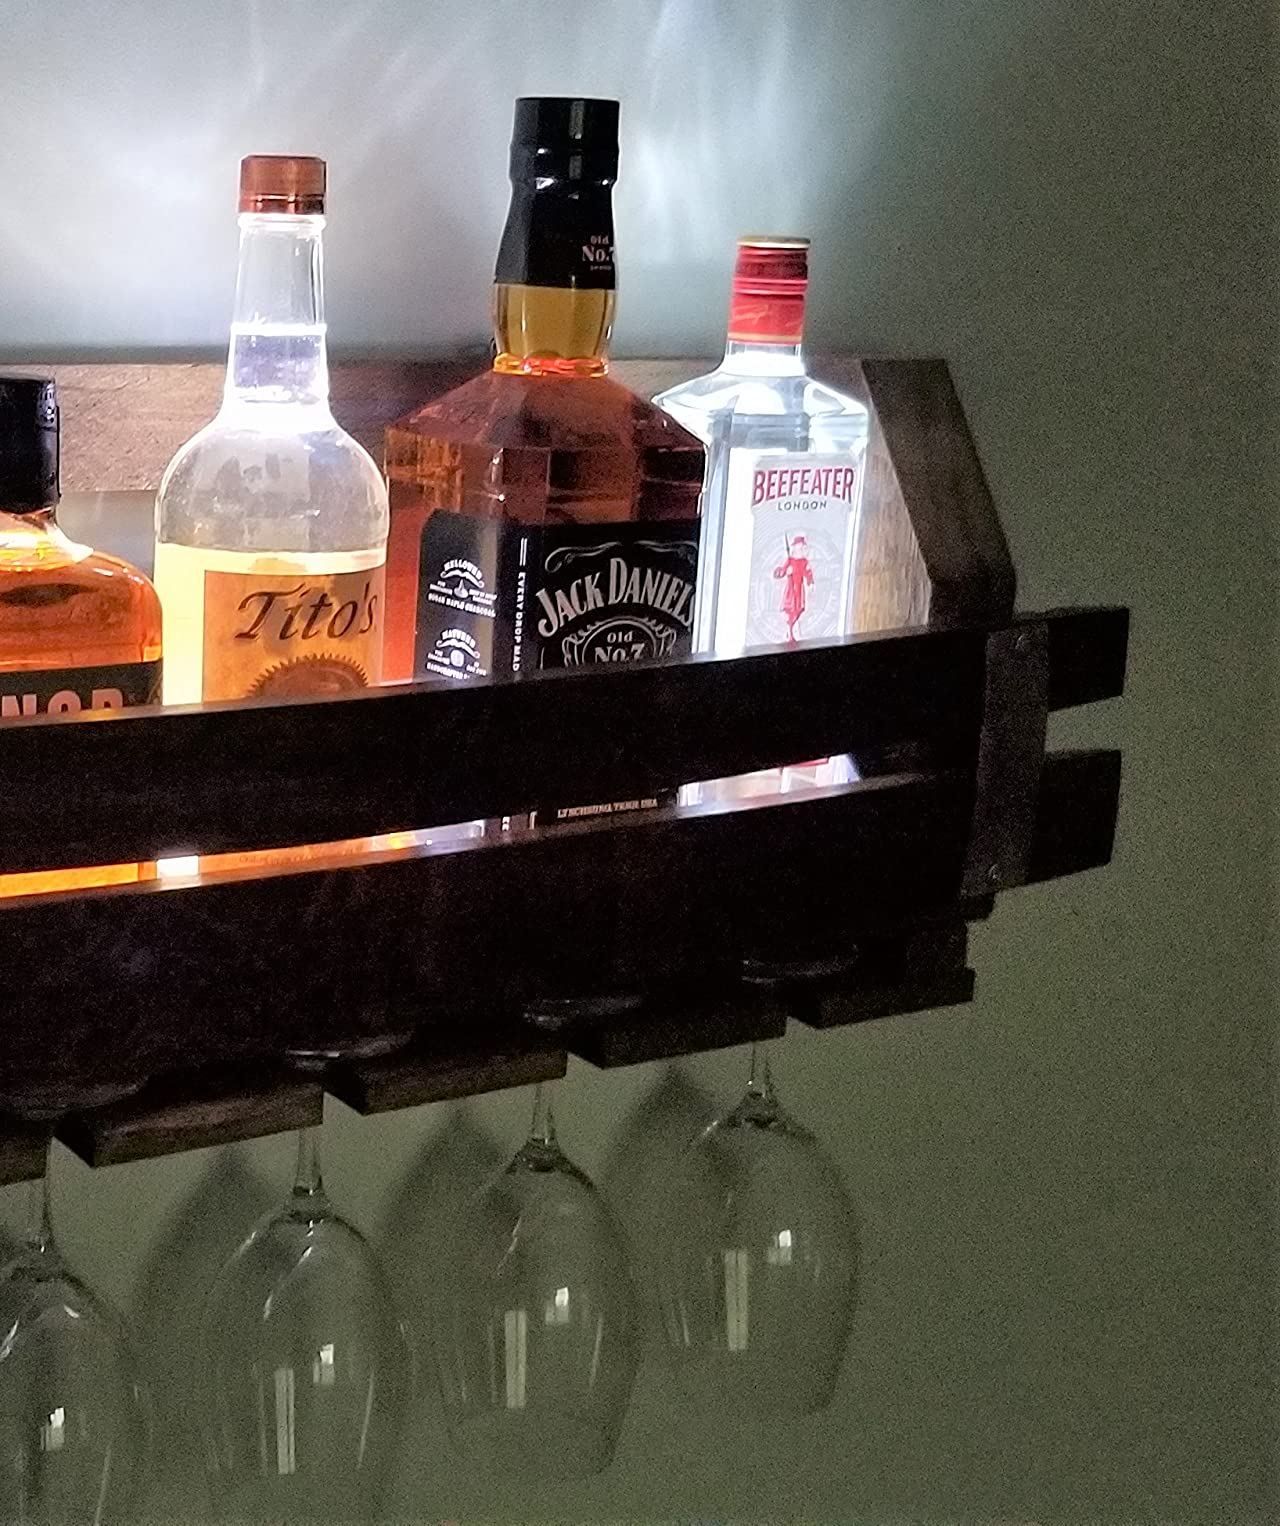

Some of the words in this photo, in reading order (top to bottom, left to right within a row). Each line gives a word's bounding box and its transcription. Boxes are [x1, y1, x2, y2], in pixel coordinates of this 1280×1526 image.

[752, 467, 855, 507] BEEFEATER
[777, 500, 828, 512] LONDON
[234, 581, 378, 641] Tito's
[535, 571, 605, 638] JACK
[608, 557, 696, 628] DANIEL
[606, 631, 634, 644] Old
